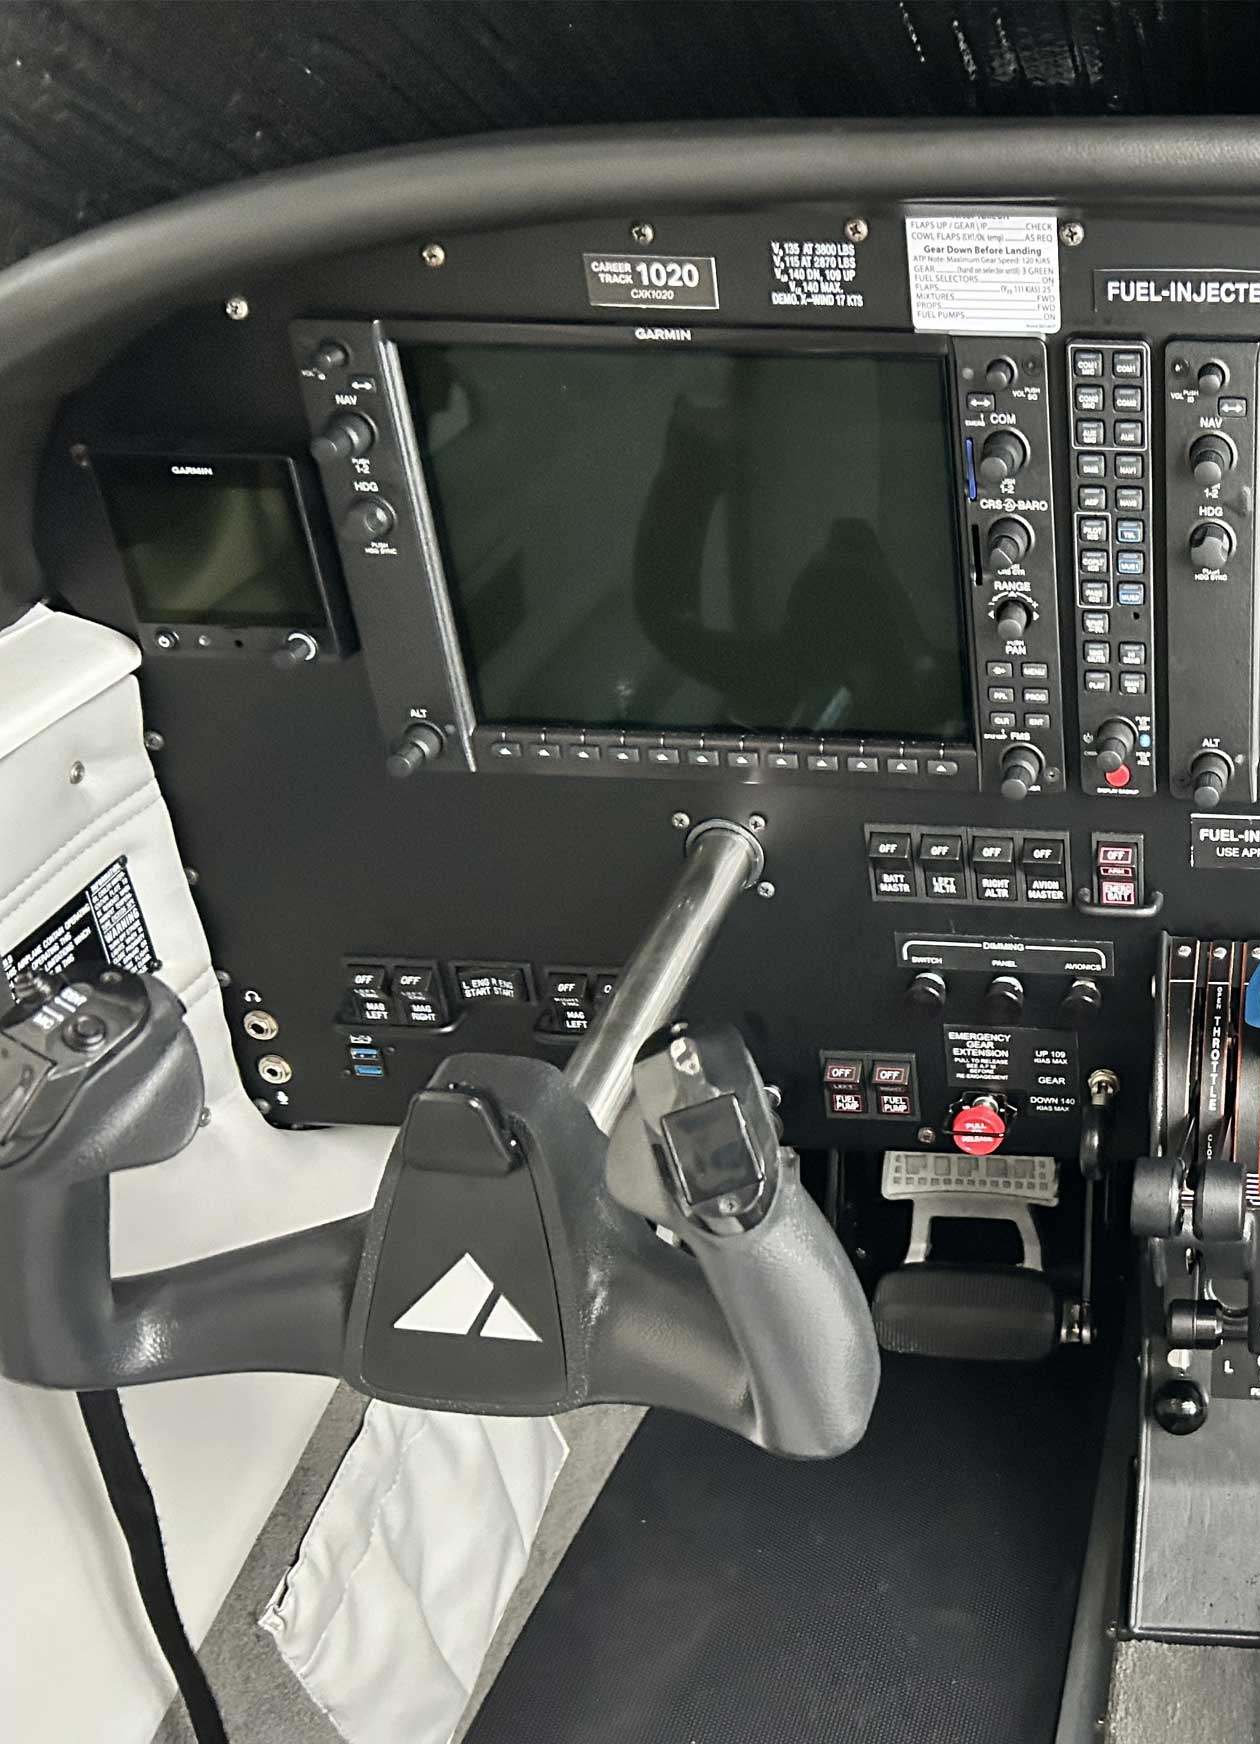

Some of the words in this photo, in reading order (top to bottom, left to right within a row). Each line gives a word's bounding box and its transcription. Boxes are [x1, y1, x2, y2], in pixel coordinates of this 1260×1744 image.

[910, 222, 935, 230] FLAPS
[912, 232, 934, 240] COWL
[1037, 234, 1052, 242] REQ
[784, 242, 800, 254] 135
[802, 243, 814, 254] AT
[815, 244, 836, 255] 3800
[838, 244, 855, 256] LBS
[924, 245, 944, 254] Gear
[947, 246, 972, 254] Down
[974, 246, 1004, 254] Before
[1006, 246, 1042, 256] Landing
[591, 261, 632, 272] CAREER
[598, 273, 633, 284] TRACK
[636, 262, 699, 288] 1020
[630, 288, 674, 300] CXK1020
[635, 328, 692, 340] GARMIN
[335, 394, 357, 405] NAV
[990, 414, 1016, 424] COM
[1200, 417, 1222, 428] NAV
[171, 465, 213, 476] GARMIN
[354, 481, 378, 492] HDG
[980, 500, 1002, 510] CRS
[1018, 501, 1048, 511] BARO
[1199, 506, 1223, 516] HDG
[994, 582, 1031, 592] RANGE
[1005, 646, 1026, 655] PAN
[410, 708, 428, 718] ALT
[1010, 732, 1030, 741] FMS
[1202, 738, 1220, 748] ALT
[879, 844, 897, 853] OFF
[931, 846, 948, 856] OFF
[982, 848, 1001, 857] OFF
[1034, 849, 1052, 858] OFF
[1216, 848, 1240, 858] USE
[883, 874, 904, 884] BATT
[932, 876, 954, 886] LEFT
[982, 879, 1010, 888] RIGHT
[880, 882, 910, 892] MASTR
[934, 884, 956, 894] ALTR
[984, 888, 1009, 898] ALTR
[1028, 890, 1064, 899] MASTER
[104, 907, 140, 944] WARNING
[982, 942, 1024, 952] DIMMING
[912, 956, 942, 964] SWITCH
[992, 960, 1018, 968] PANEL
[1065, 963, 1102, 971] AVIONICS
[354, 975, 373, 984] OFF
[400, 976, 421, 985] OFF
[558, 983, 575, 992] OFF
[366, 1002, 384, 1011] MAG
[412, 1004, 432, 1012] MAG
[366, 1010, 388, 1020] LEFT
[412, 1012, 436, 1022] RIGHT
[567, 1011, 585, 1020] MAG
[566, 1020, 588, 1028] LEFT
[948, 1032, 1010, 1042] EMERGENCY
[953, 1048, 1008, 1058] EXTENSION
[1209, 1016, 1221, 1111] THROTTLE
[832, 1068, 851, 1078] OFF
[880, 1070, 899, 1080] OFF
[1038, 1076, 1066, 1084] GEAR
[836, 1095, 856, 1104] FUEL
[884, 1096, 906, 1105] FUEL
[837, 1103, 860, 1111] PUMP
[884, 1104, 907, 1113] PUMP
[1224, 1361, 1233, 1372] L
